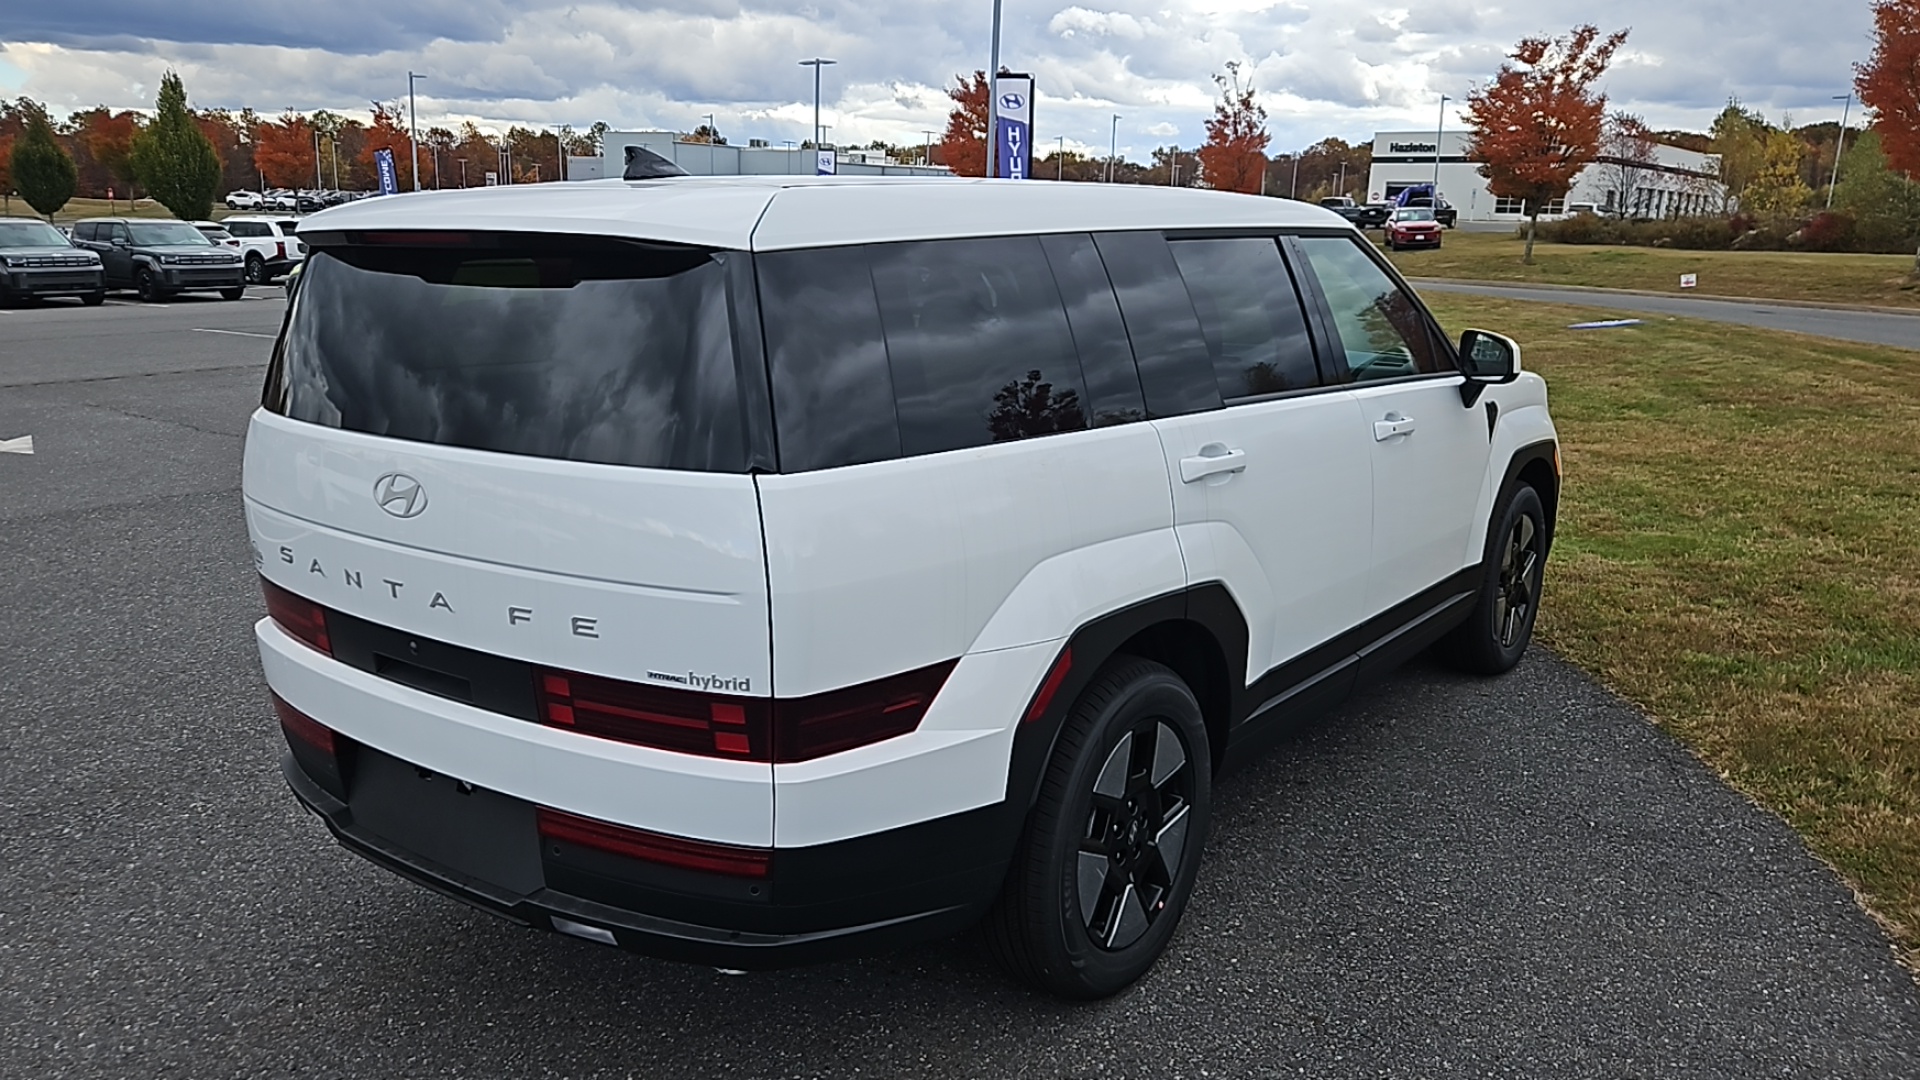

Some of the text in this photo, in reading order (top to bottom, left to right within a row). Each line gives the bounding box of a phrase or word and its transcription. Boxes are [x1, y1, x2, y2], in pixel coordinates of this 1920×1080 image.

[1389, 142, 1437, 153] Hazleton
[279, 545, 456, 613] SANTA
[508, 606, 600, 639] FE
[688, 671, 751, 692] hybrid
